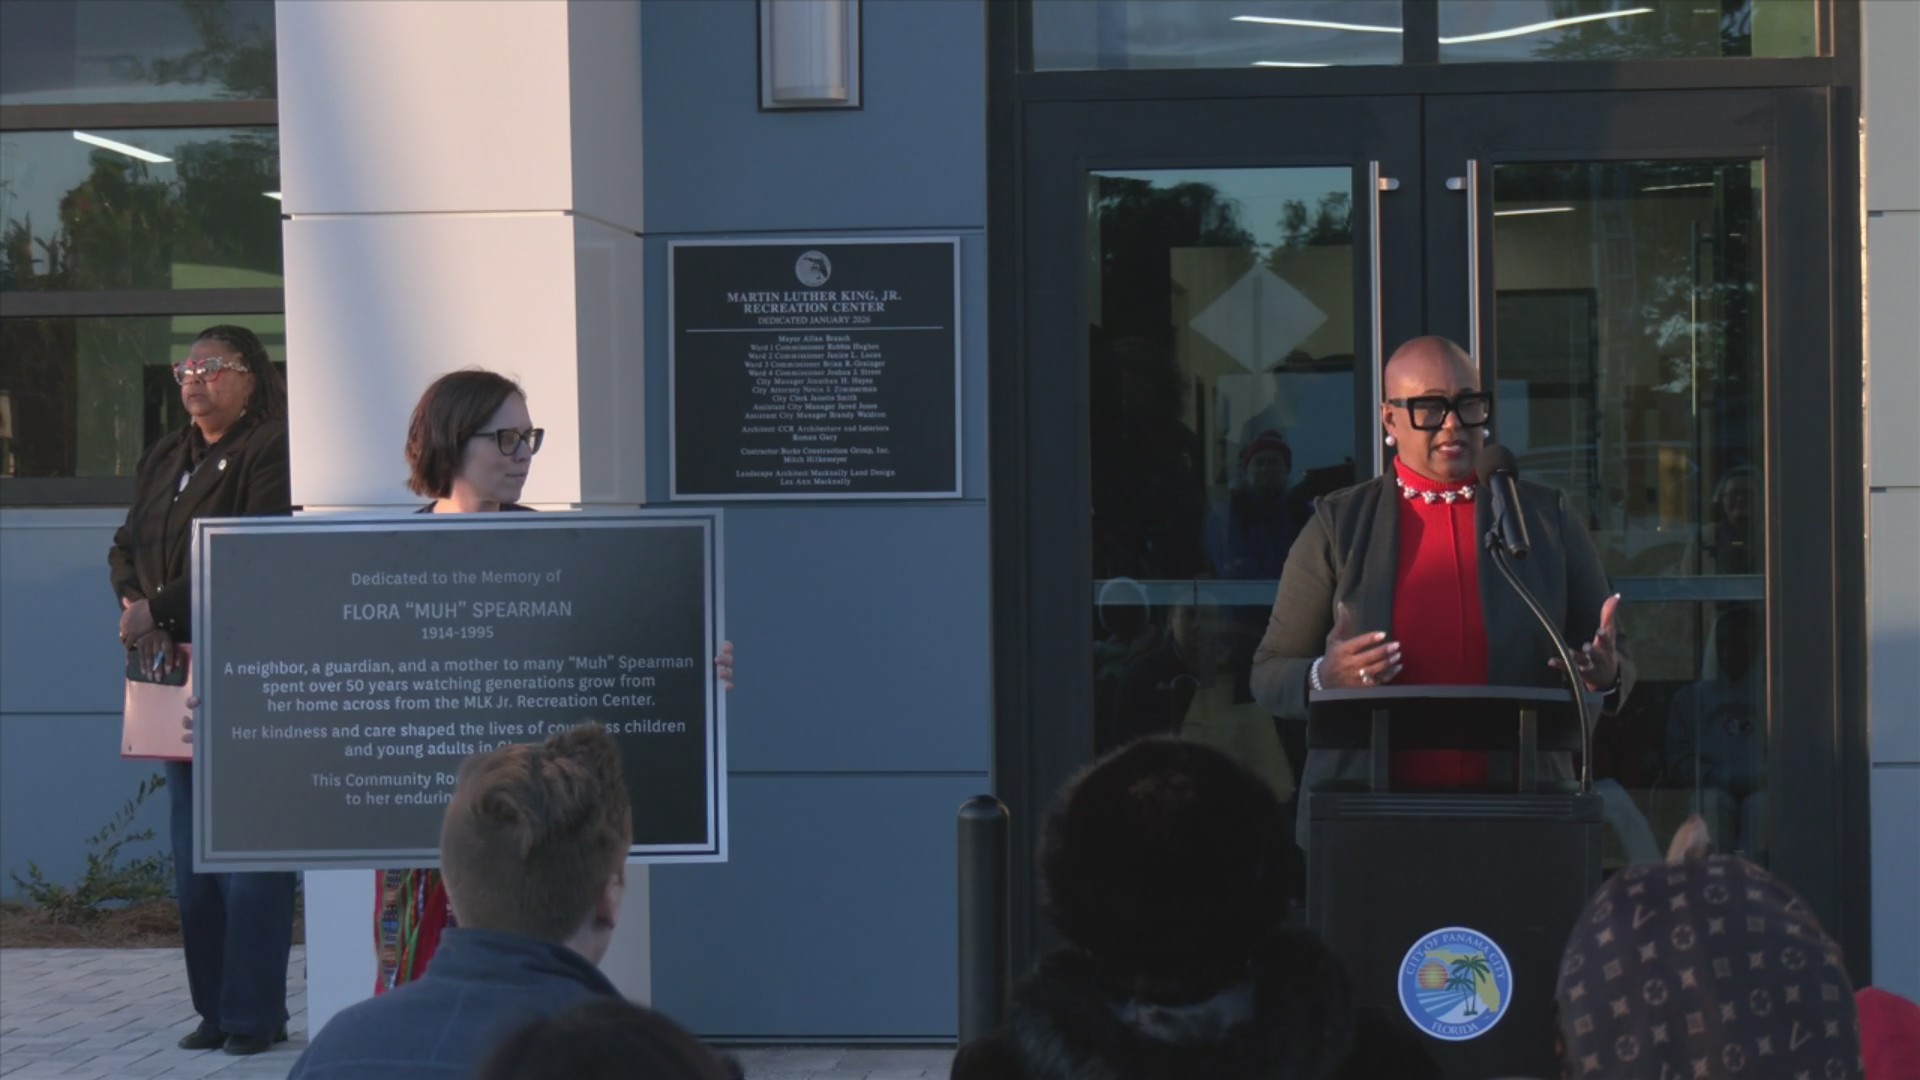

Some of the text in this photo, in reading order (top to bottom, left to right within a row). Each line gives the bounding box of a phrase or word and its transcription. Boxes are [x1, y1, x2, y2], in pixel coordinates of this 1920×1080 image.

[727, 290, 903, 302] MARTIN LUTHER KING, JR.
[744, 302, 884, 313] RECREATION CENTER
[758, 316, 808, 324] DEDICATED
[778, 335, 800, 343] Mayor
[773, 377, 804, 385] Manager
[752, 386, 767, 394] City
[772, 394, 787, 402] City
[804, 403, 835, 411] Manager
[351, 569, 561, 586] Dedicated to the Memory of
[343, 600, 571, 620] FLORA “MUH” SPEARMAN
[422, 625, 494, 639] 1914-1995
[224, 654, 693, 678] A neighbor, a guardian, and a mother to many “Muh” Spearman
[262, 673, 655, 696] spent over 50 years watching generations grow from
[267, 693, 656, 711] her home across from the MLK Jr. Recreation Center.
[232, 727, 256, 738] Her
[262, 724, 327, 738] kindness
[331, 724, 359, 737] and
[364, 726, 396, 737] care
[400, 722, 455, 739] shaped
[459, 722, 484, 735] the
[489, 721, 523, 735] lives
[527, 720, 544, 734] of
[624, 720, 686, 733] children
[344, 743, 372, 756] and
[377, 744, 423, 759] young
[427, 740, 474, 755] adults
[478, 740, 492, 753] in
[312, 773, 341, 786] This
[345, 772, 431, 789] Community
[345, 790, 453, 804] to her endurin
[1406, 933, 1506, 980] CITY OF PANAMA CITY
[1431, 1020, 1479, 1036] FLORIDA
